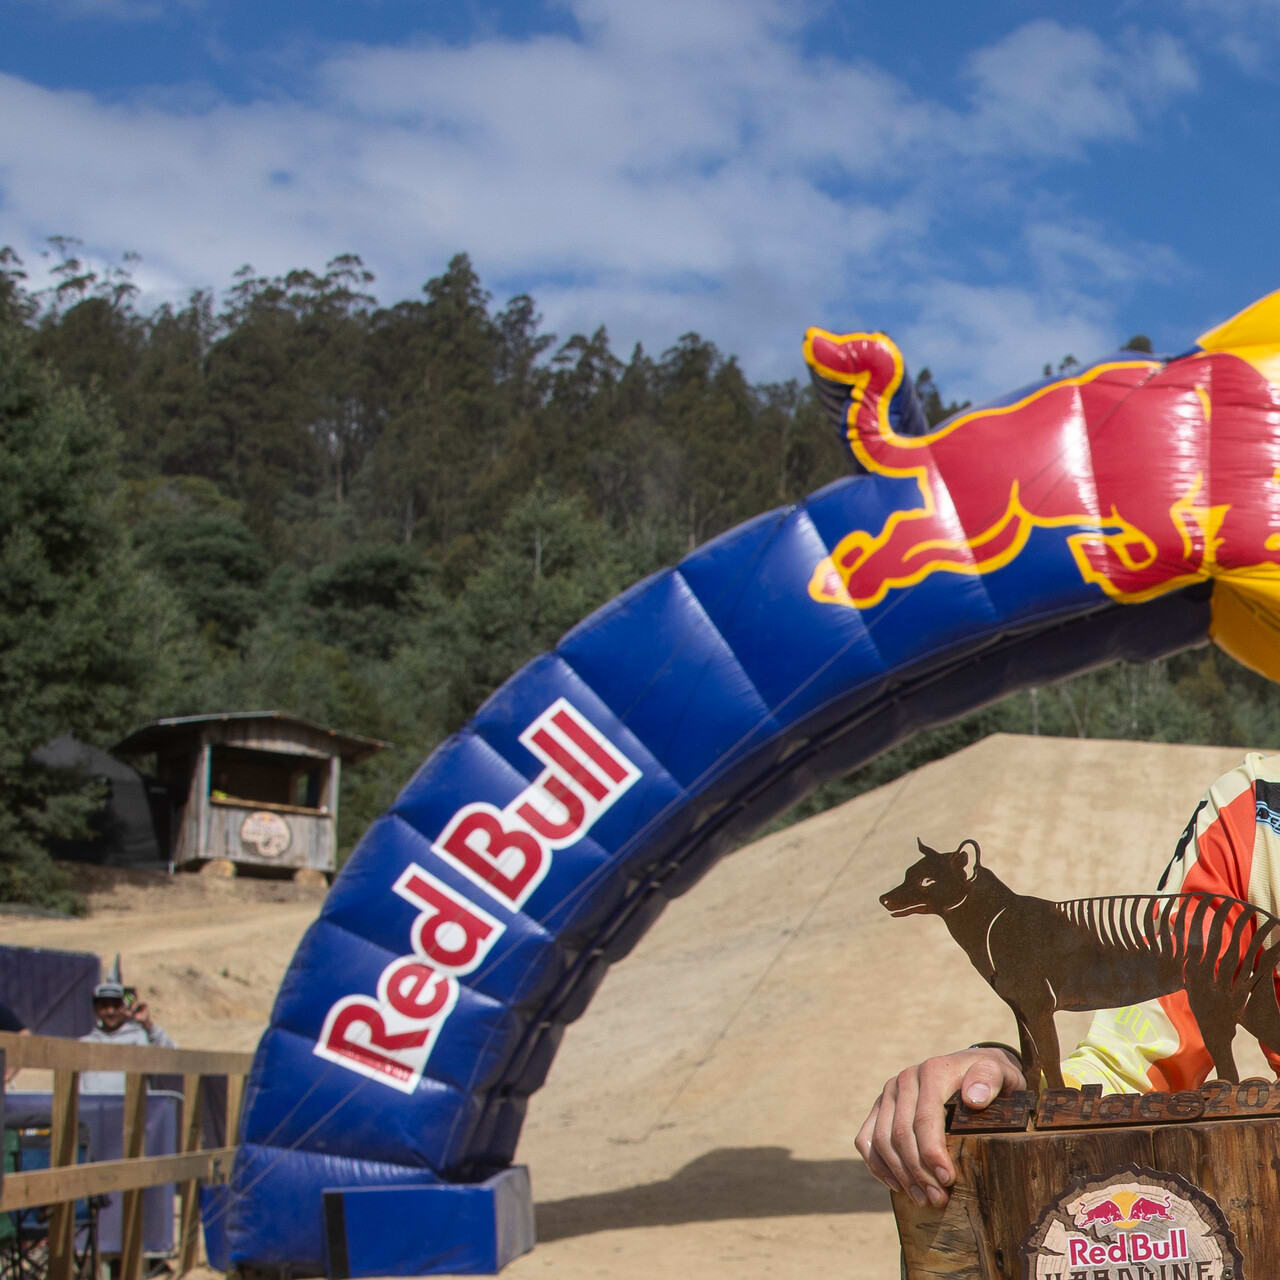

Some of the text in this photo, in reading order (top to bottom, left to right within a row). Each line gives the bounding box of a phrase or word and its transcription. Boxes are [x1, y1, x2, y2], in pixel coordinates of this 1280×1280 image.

[320, 868, 502, 1089] Red
[437, 703, 637, 907] Bull
[1069, 1229, 1187, 1266] Red Bull
